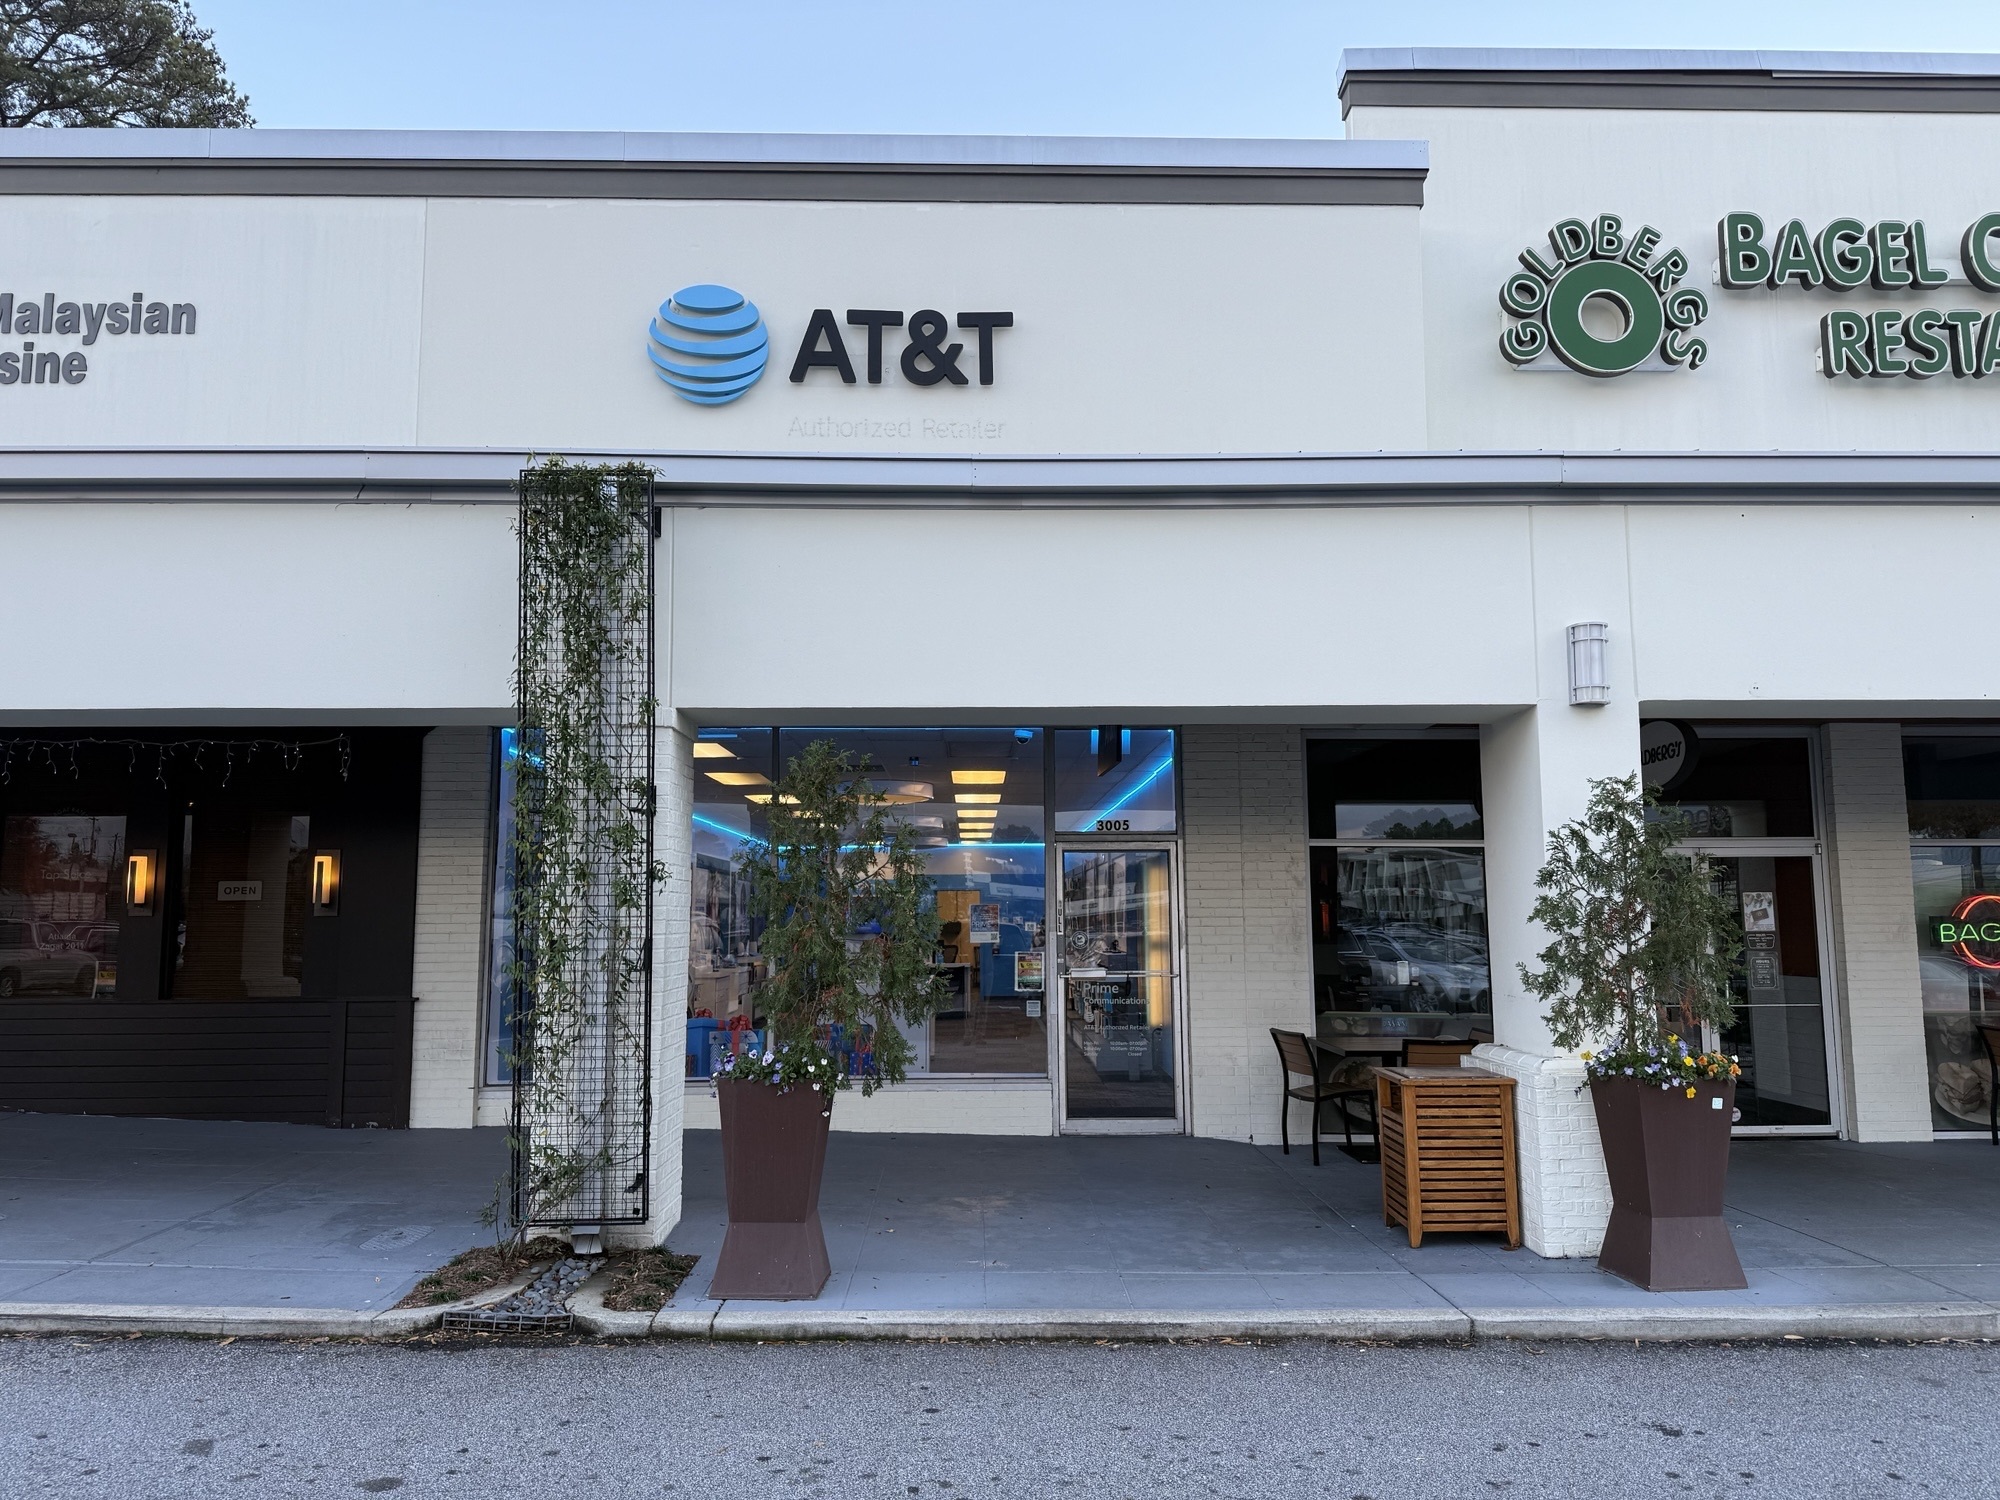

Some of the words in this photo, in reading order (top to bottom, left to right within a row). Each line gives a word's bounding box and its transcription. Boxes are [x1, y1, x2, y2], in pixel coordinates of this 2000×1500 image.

[1717, 210, 1951, 292] BAGEL
[789, 309, 1014, 386] AT&T
[787, 416, 911, 439] Authorized
[922, 418, 1006, 439] Retailer
[1096, 819, 1130, 831] 3005
[224, 886, 256, 895] OPEN
[1939, 923, 2000, 943] BAG
[1083, 982, 1120, 994] Prime
[1083, 996, 1151, 1006] Communications
